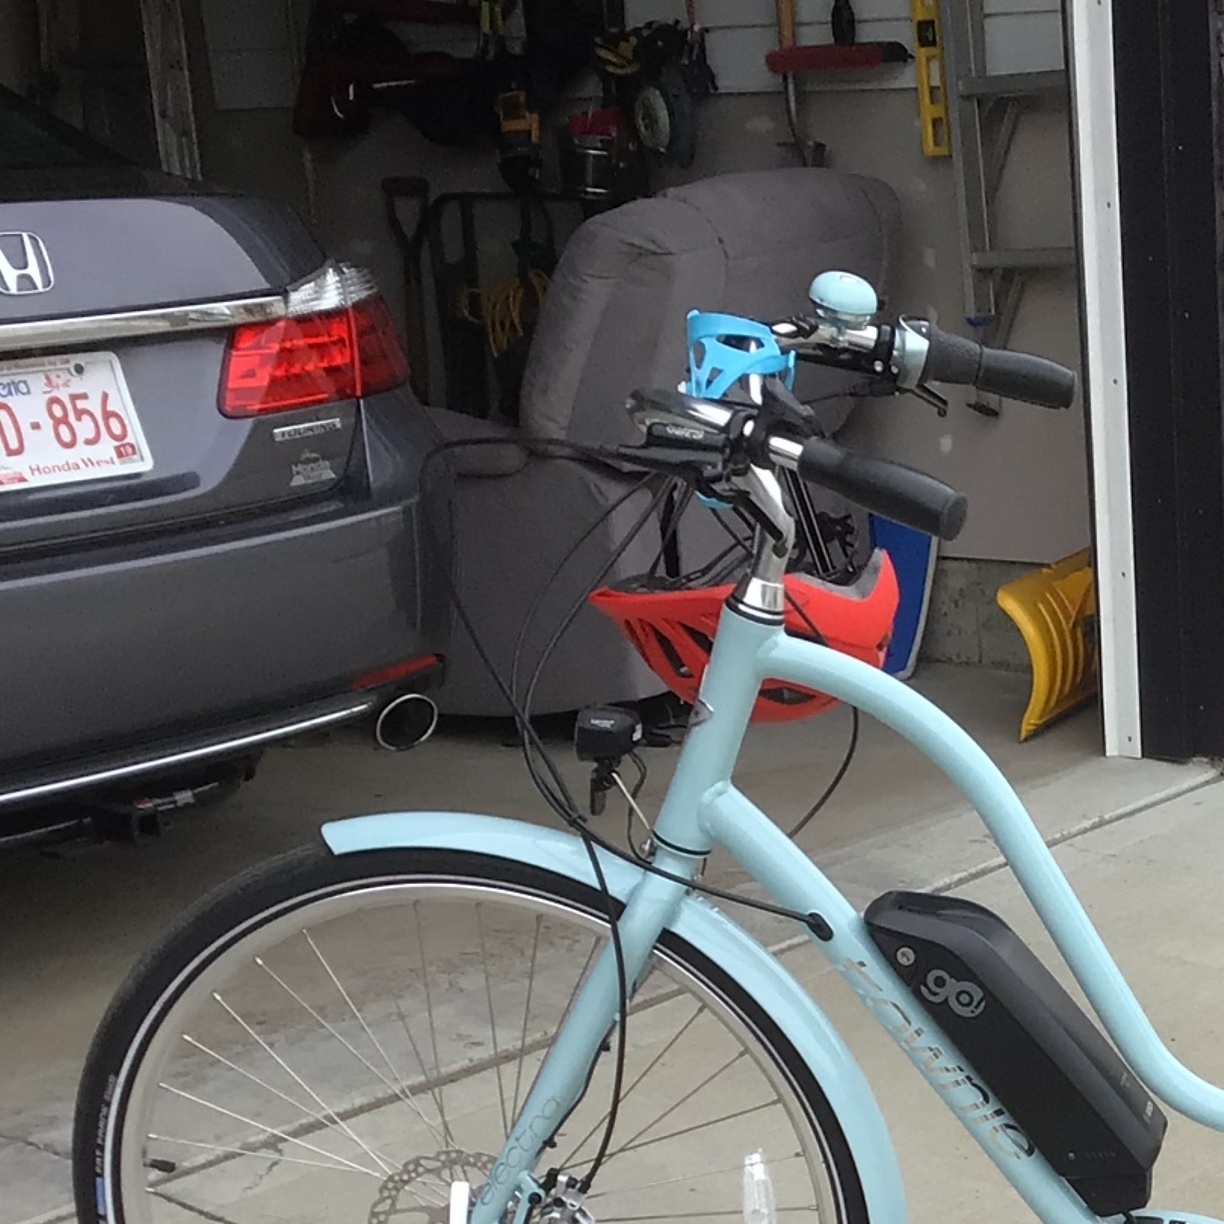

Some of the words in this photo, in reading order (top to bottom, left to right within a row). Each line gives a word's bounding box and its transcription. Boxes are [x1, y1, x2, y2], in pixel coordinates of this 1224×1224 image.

[29, 461, 81, 476] Honda
[81, 456, 115, 468] West
[481, 1096, 560, 1206] electra
